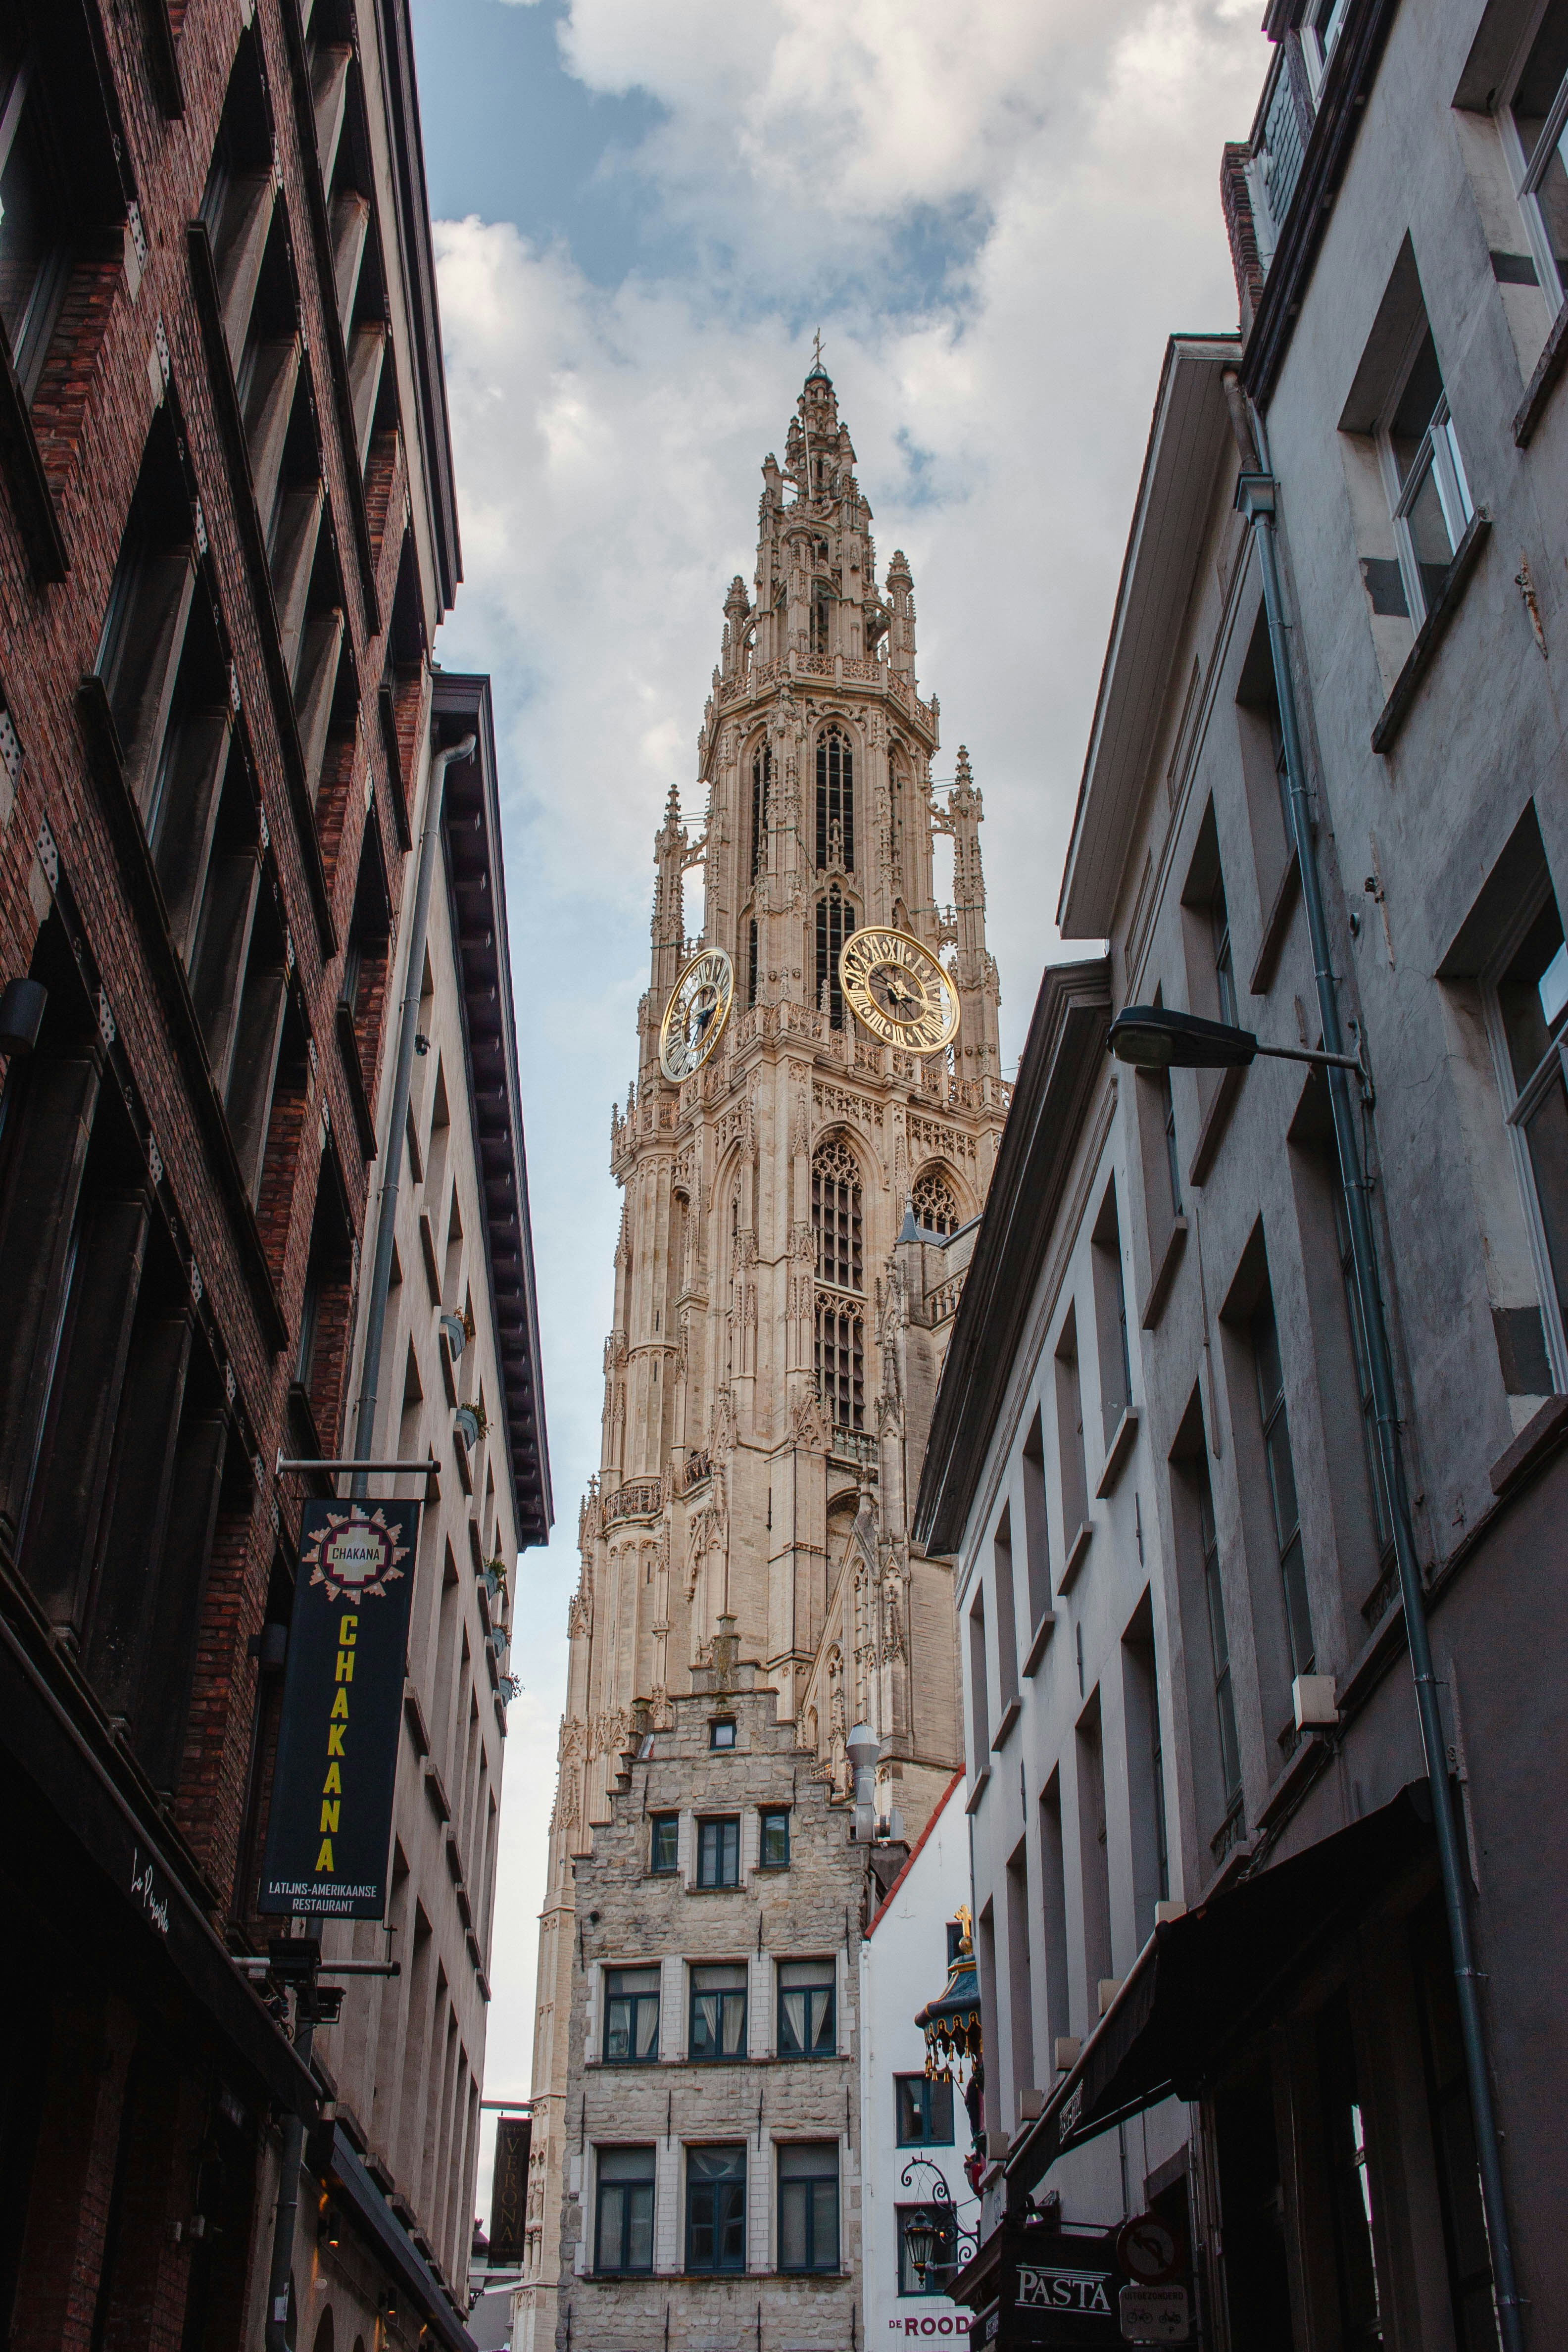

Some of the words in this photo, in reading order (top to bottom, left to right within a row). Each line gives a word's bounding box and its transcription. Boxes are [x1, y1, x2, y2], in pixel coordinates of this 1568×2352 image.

[332, 1547, 380, 1560] CHAKANA
[315, 1615, 358, 1872] CHAKANA
[269, 1882, 377, 1897] LATIJNS-AMERIKAANSE
[292, 1898, 354, 1912] RESTAURANT
[500, 2137, 519, 2242] VERONA
[1015, 2269, 1111, 2310] PASTA
[1124, 2291, 1184, 2301] UITGEZONDERD
[889, 2320, 903, 2328] DE
[905, 2316, 976, 2336] ROOD
